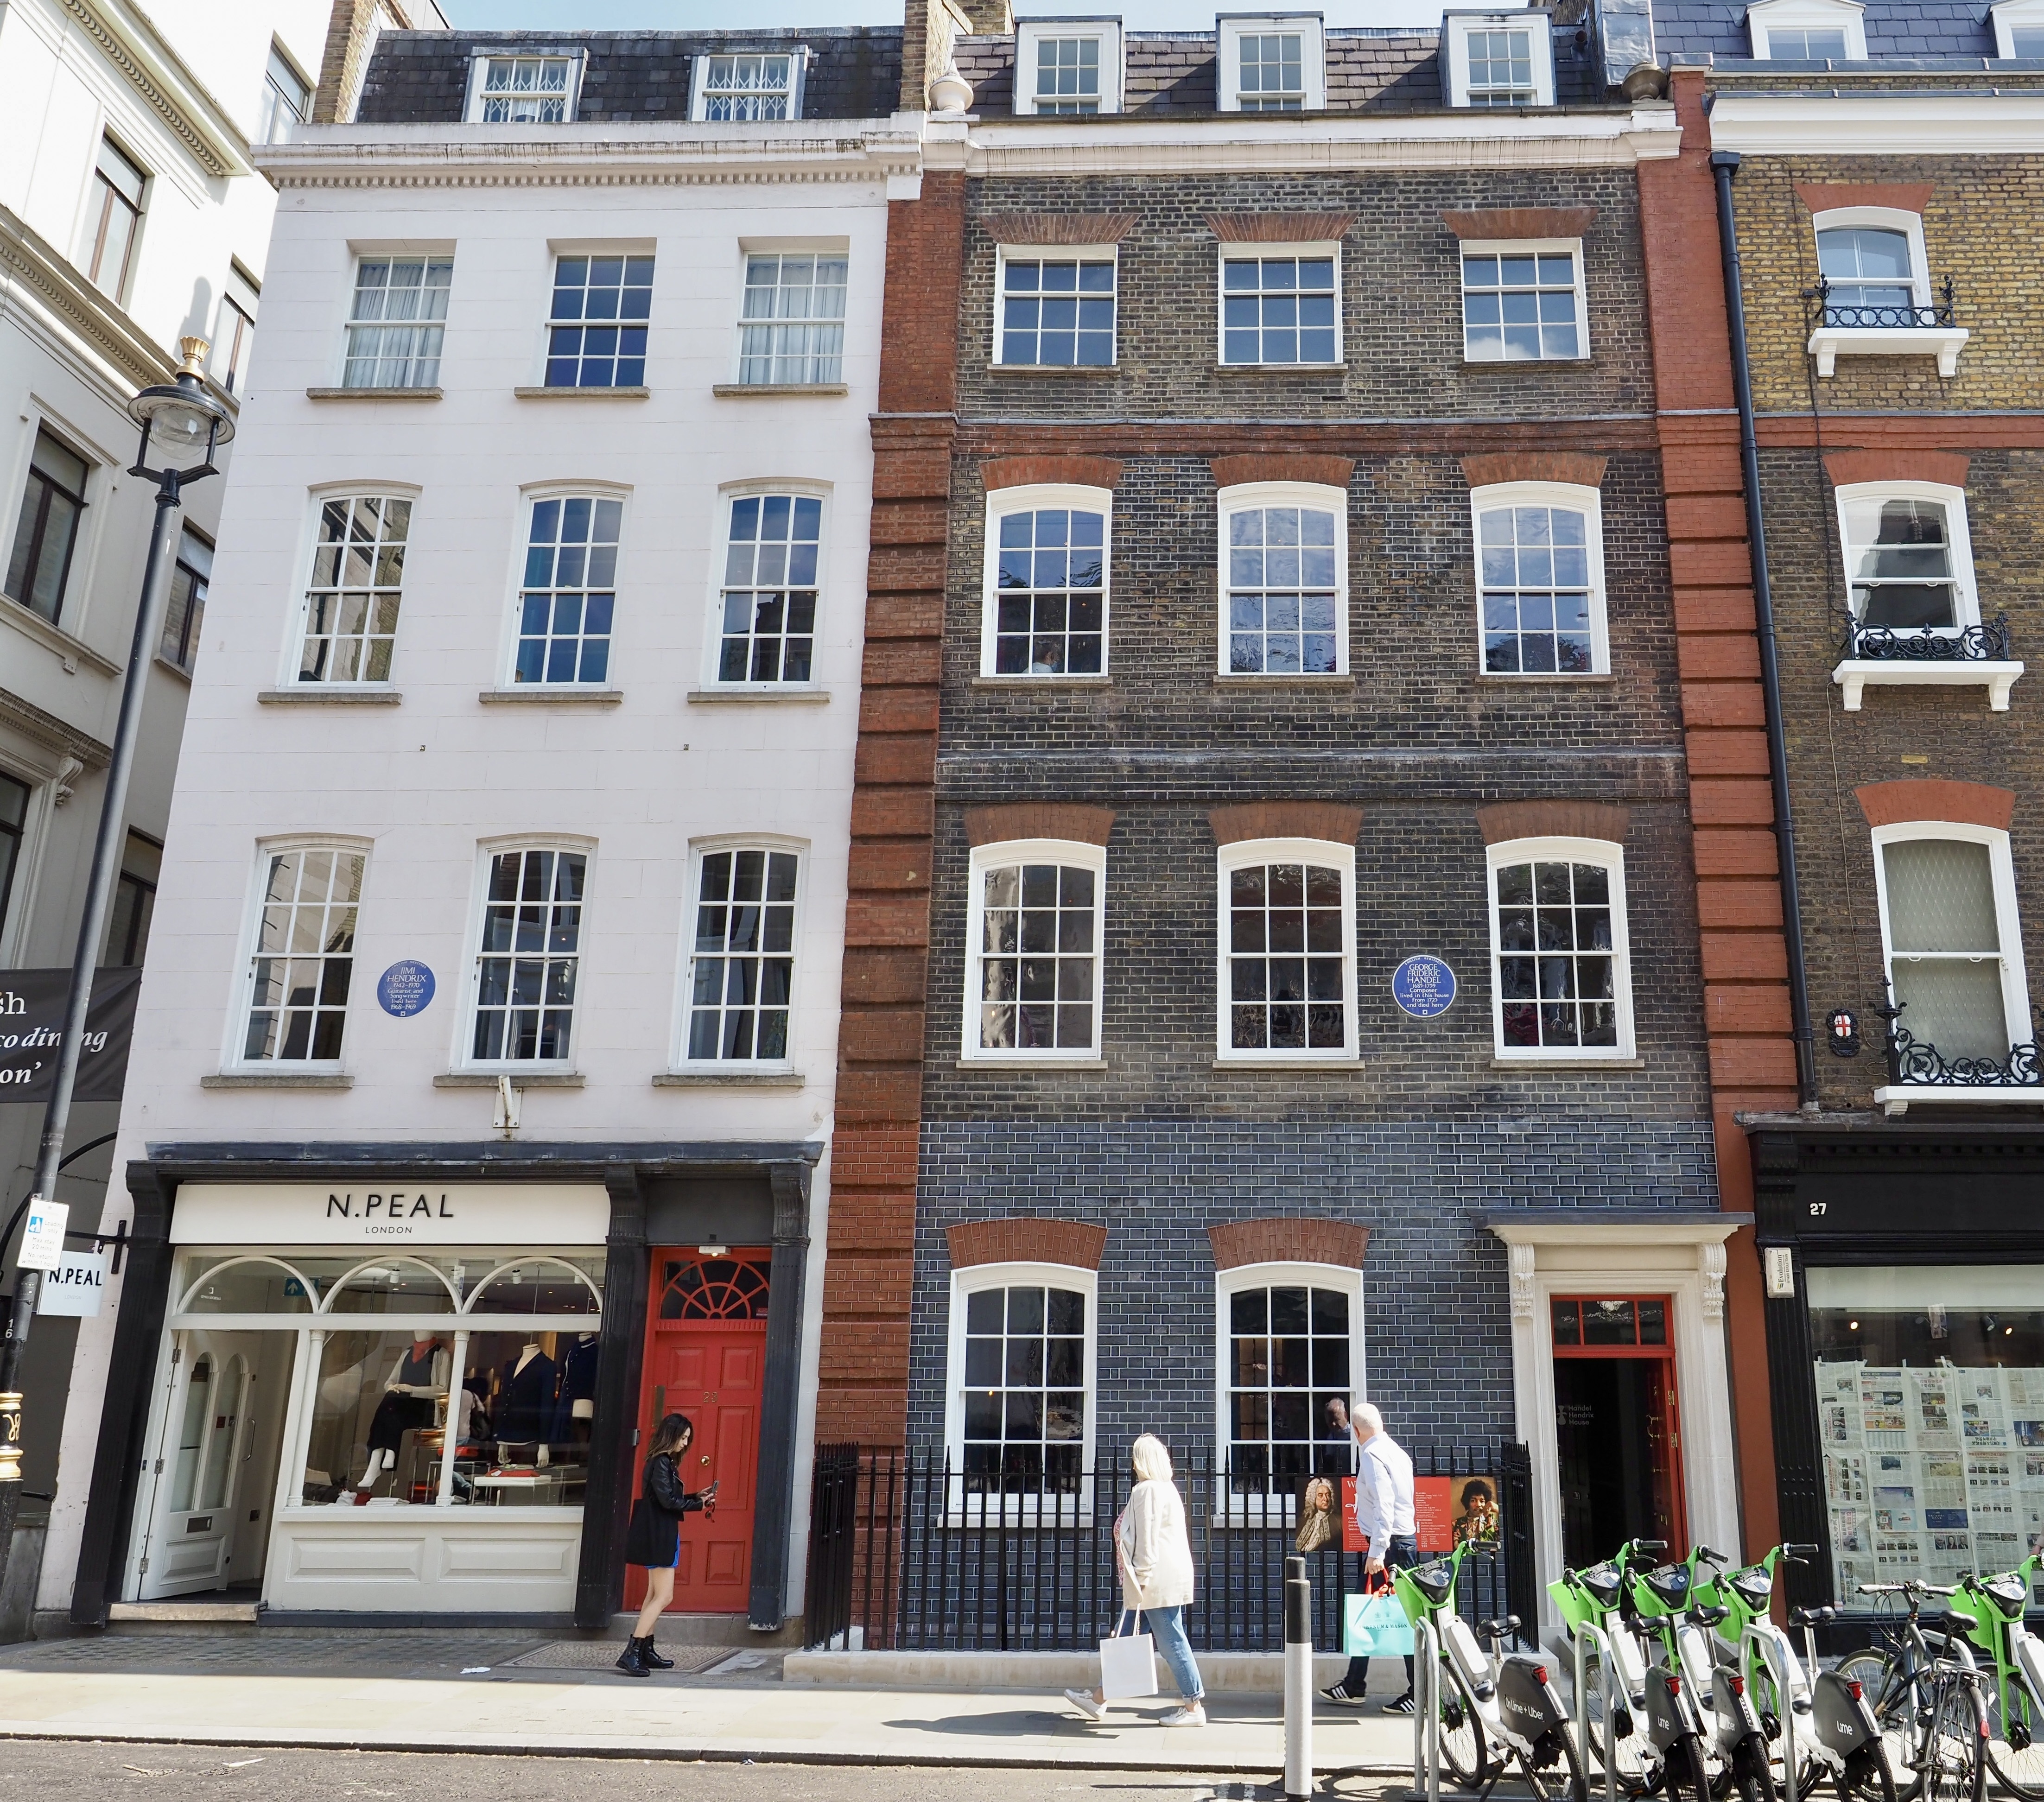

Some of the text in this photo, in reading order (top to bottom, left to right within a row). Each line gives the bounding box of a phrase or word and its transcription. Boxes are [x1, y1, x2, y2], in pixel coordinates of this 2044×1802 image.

[21, 1027, 108, 1053] dinng
[327, 1194, 454, 1218] N.PEAL
[1810, 1203, 1827, 1215] 27
[49, 1267, 102, 1286] N.PEAL
[703, 1391, 717, 1402] 23
[1511, 1699, 1523, 1714] Lime
[1528, 1706, 1543, 1720] Uber
[1657, 1716, 1669, 1730] Lime
[1836, 1720, 1853, 1735] Lime
